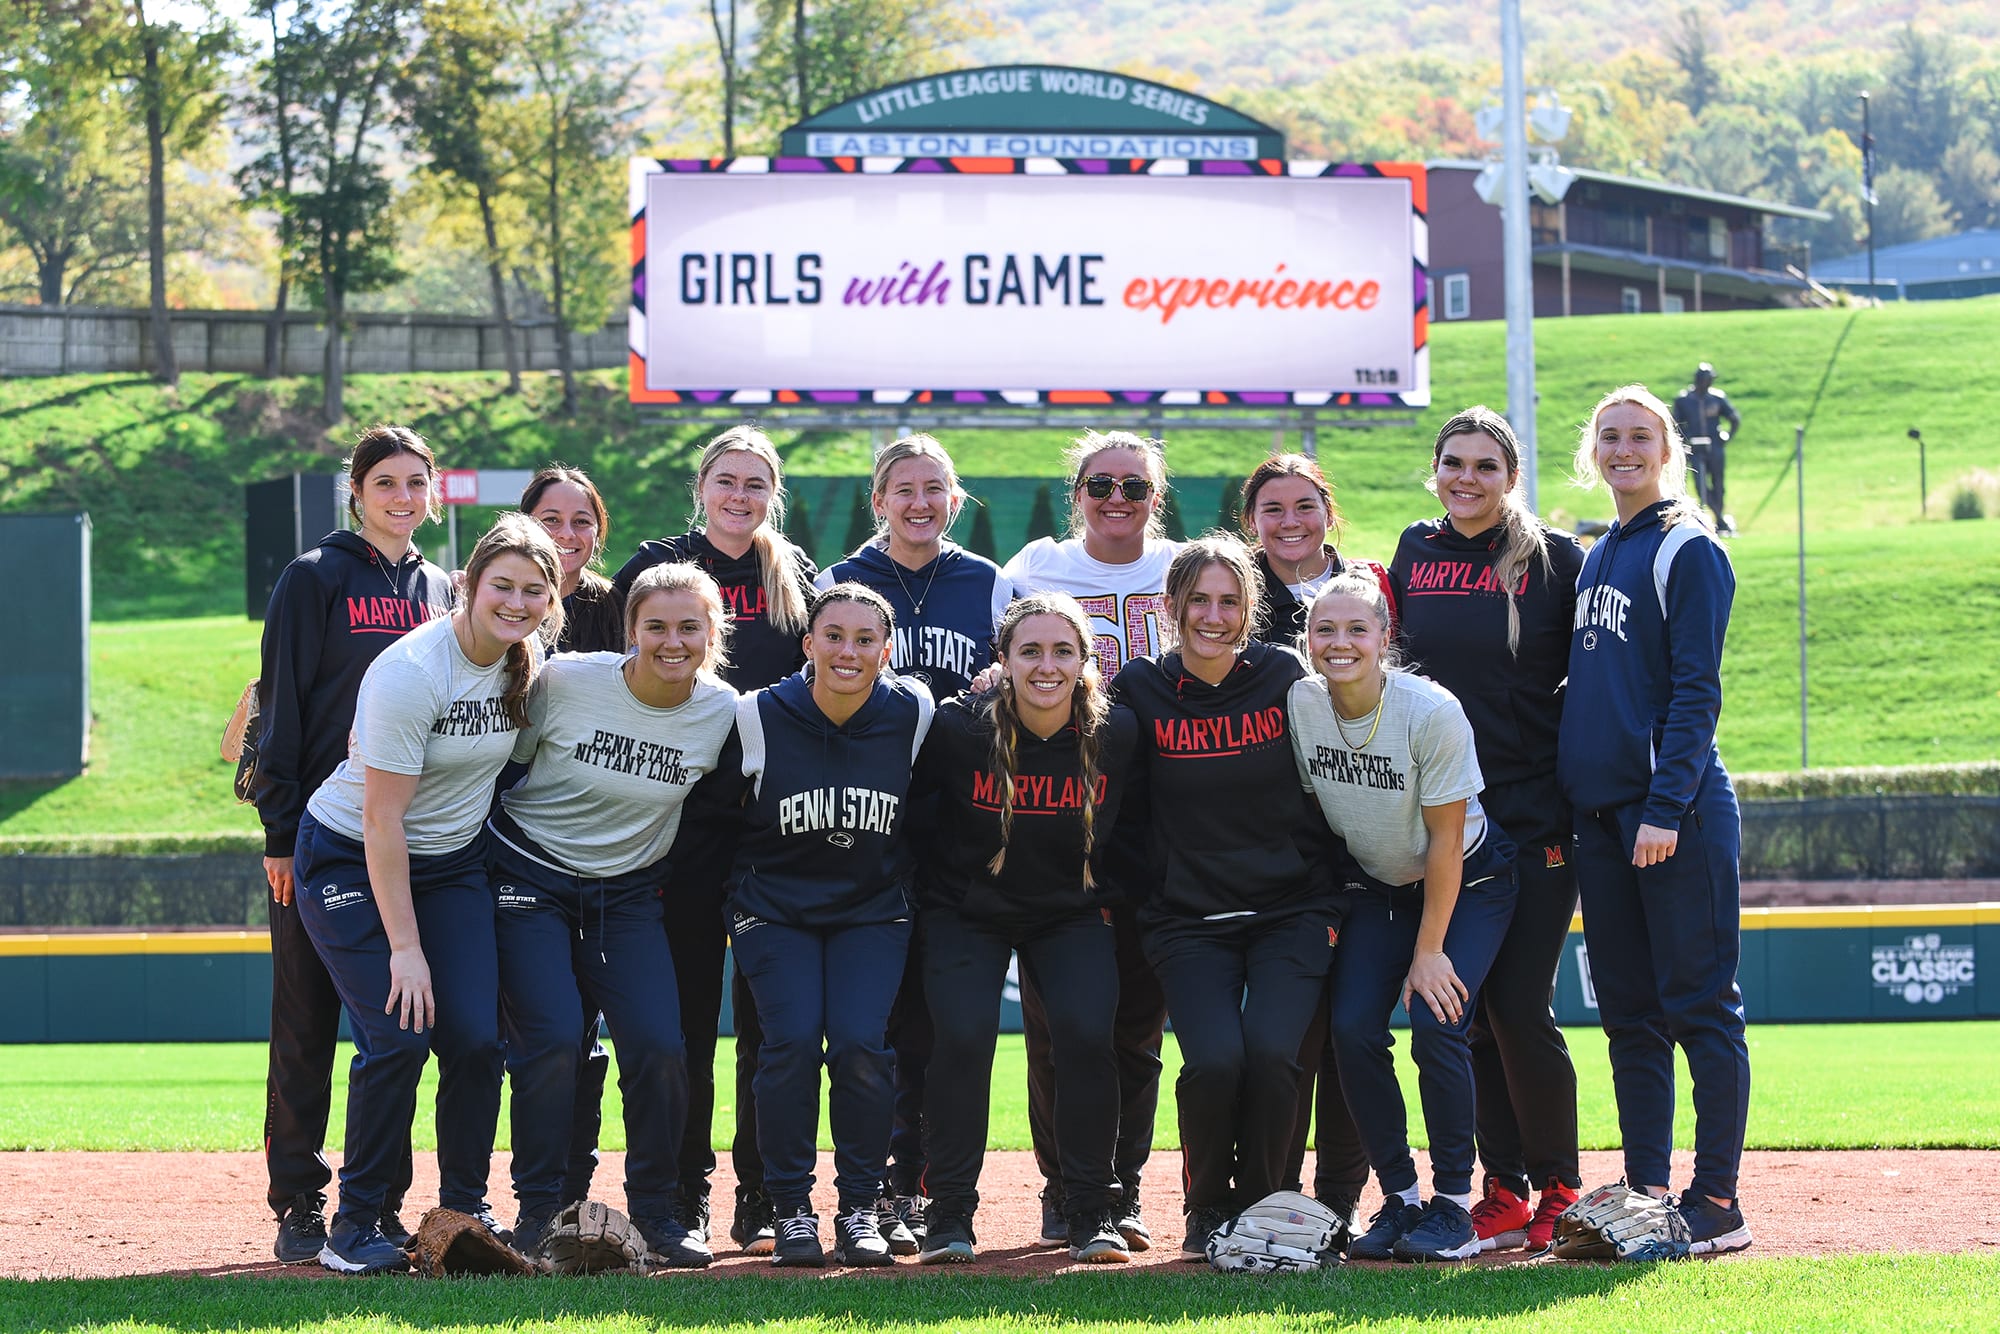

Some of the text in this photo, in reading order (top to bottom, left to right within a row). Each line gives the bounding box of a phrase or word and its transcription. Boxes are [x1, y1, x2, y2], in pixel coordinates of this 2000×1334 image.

[856, 81, 936, 124] LITTLE
[1040, 70, 1127, 100] WORLD
[1130, 82, 1209, 125] SERIES
[815, 136, 1250, 156] EASTON FOUNDATIONS
[681, 253, 1380, 325] GIRLS with GAME experience
[1591, 584, 1631, 640] STATE
[919, 625, 976, 682] STATE
[431, 714, 490, 737] NITTANY
[449, 700, 481, 724] PENN
[1154, 706, 1284, 751] MARYLAND
[574, 742, 689, 786] NITTANY LIONS
[592, 729, 684, 768] PENN STATE
[1315, 745, 1392, 774] PENN STATE
[1308, 758, 1405, 791] NITTANY LIONS
[779, 786, 900, 836] PENN STATE
[1544, 845, 1565, 868] M
